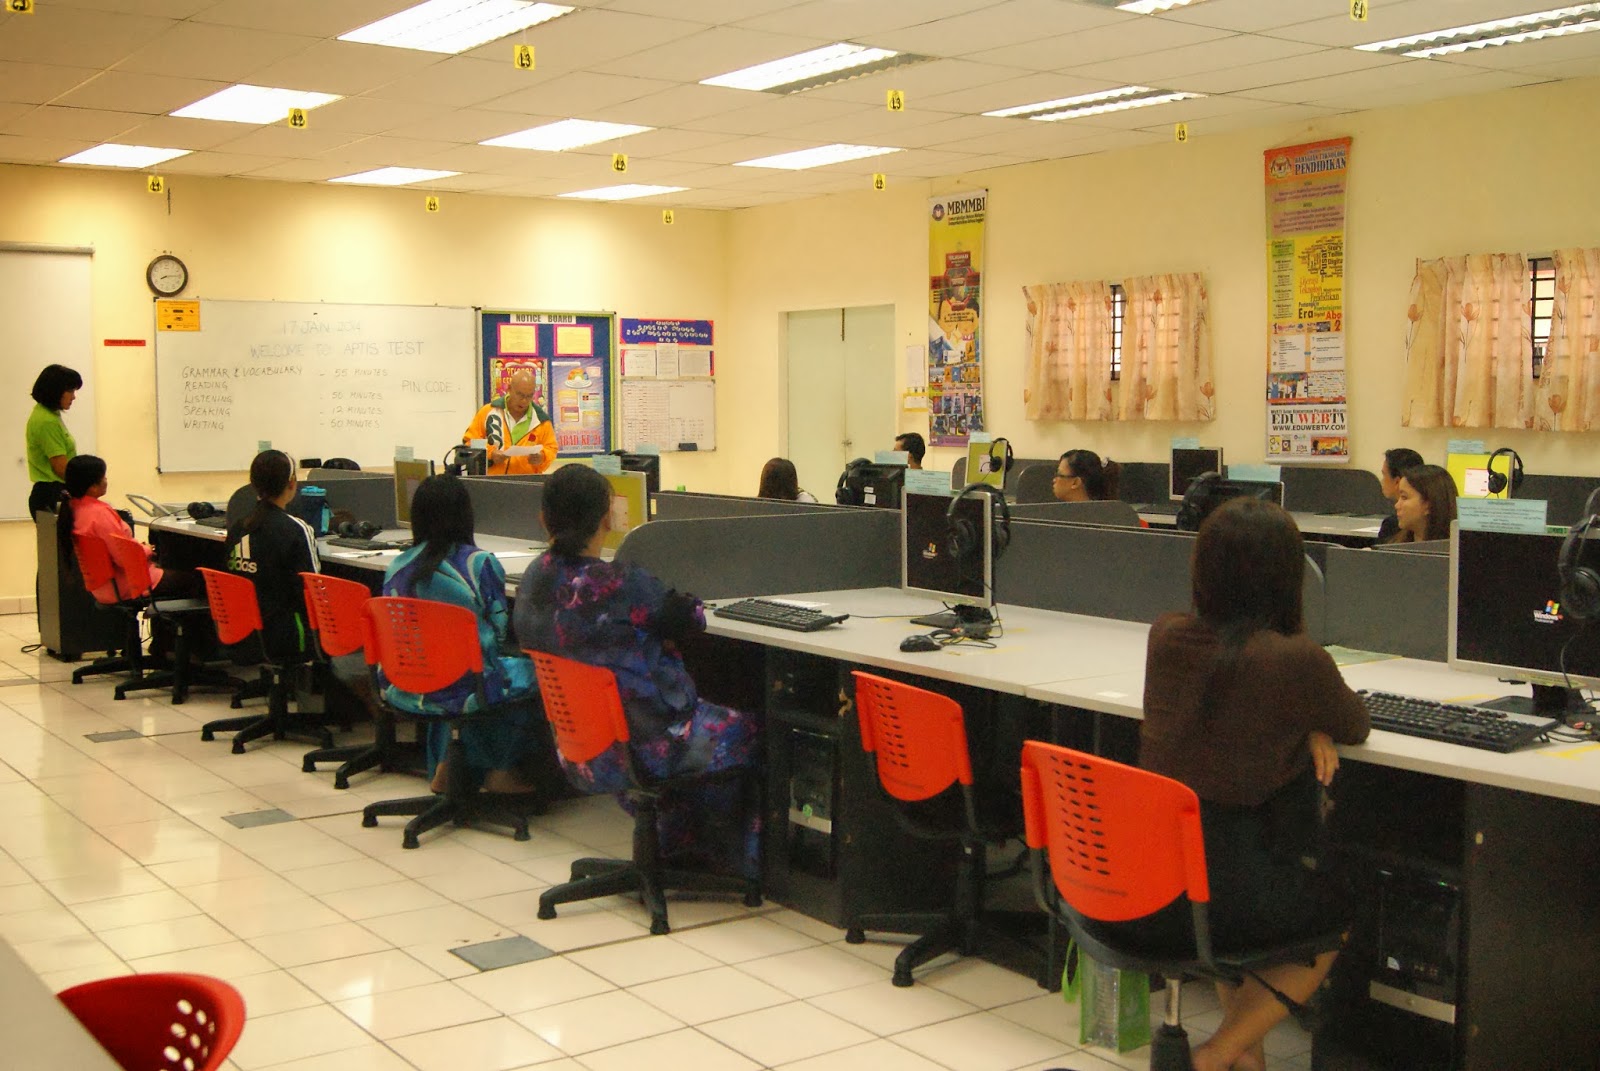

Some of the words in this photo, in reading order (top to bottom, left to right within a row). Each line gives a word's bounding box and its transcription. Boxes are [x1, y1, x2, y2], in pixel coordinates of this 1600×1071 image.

[519, 53, 531, 68] L3
[891, 96, 902, 110] L3
[1295, 157, 1346, 175] PENDIDIKAN
[947, 197, 986, 216] MBMMBI
[515, 313, 541, 323] NOTICE
[547, 314, 573, 323] BOARD
[1298, 308, 1314, 319] Era
[300, 320, 330, 335] JAN
[344, 341, 379, 356] APTIS
[387, 340, 425, 356] TEST
[182, 365, 230, 379] GRAMMAR
[242, 365, 303, 377] VOCABULARY
[354, 368, 389, 377] MINUTES
[184, 380, 228, 391] READING
[401, 379, 421, 393] PIN
[425, 380, 453, 393] CODE
[184, 394, 233, 404] LISTENING
[349, 391, 384, 401] MINUTES
[183, 405, 231, 417] SPEAKING
[347, 406, 384, 416] MINUTES
[183, 419, 225, 430] WRITING
[346, 419, 380, 429] MINUTES
[1272, 424, 1346, 432] WWW.EDUWEBTV.COM
